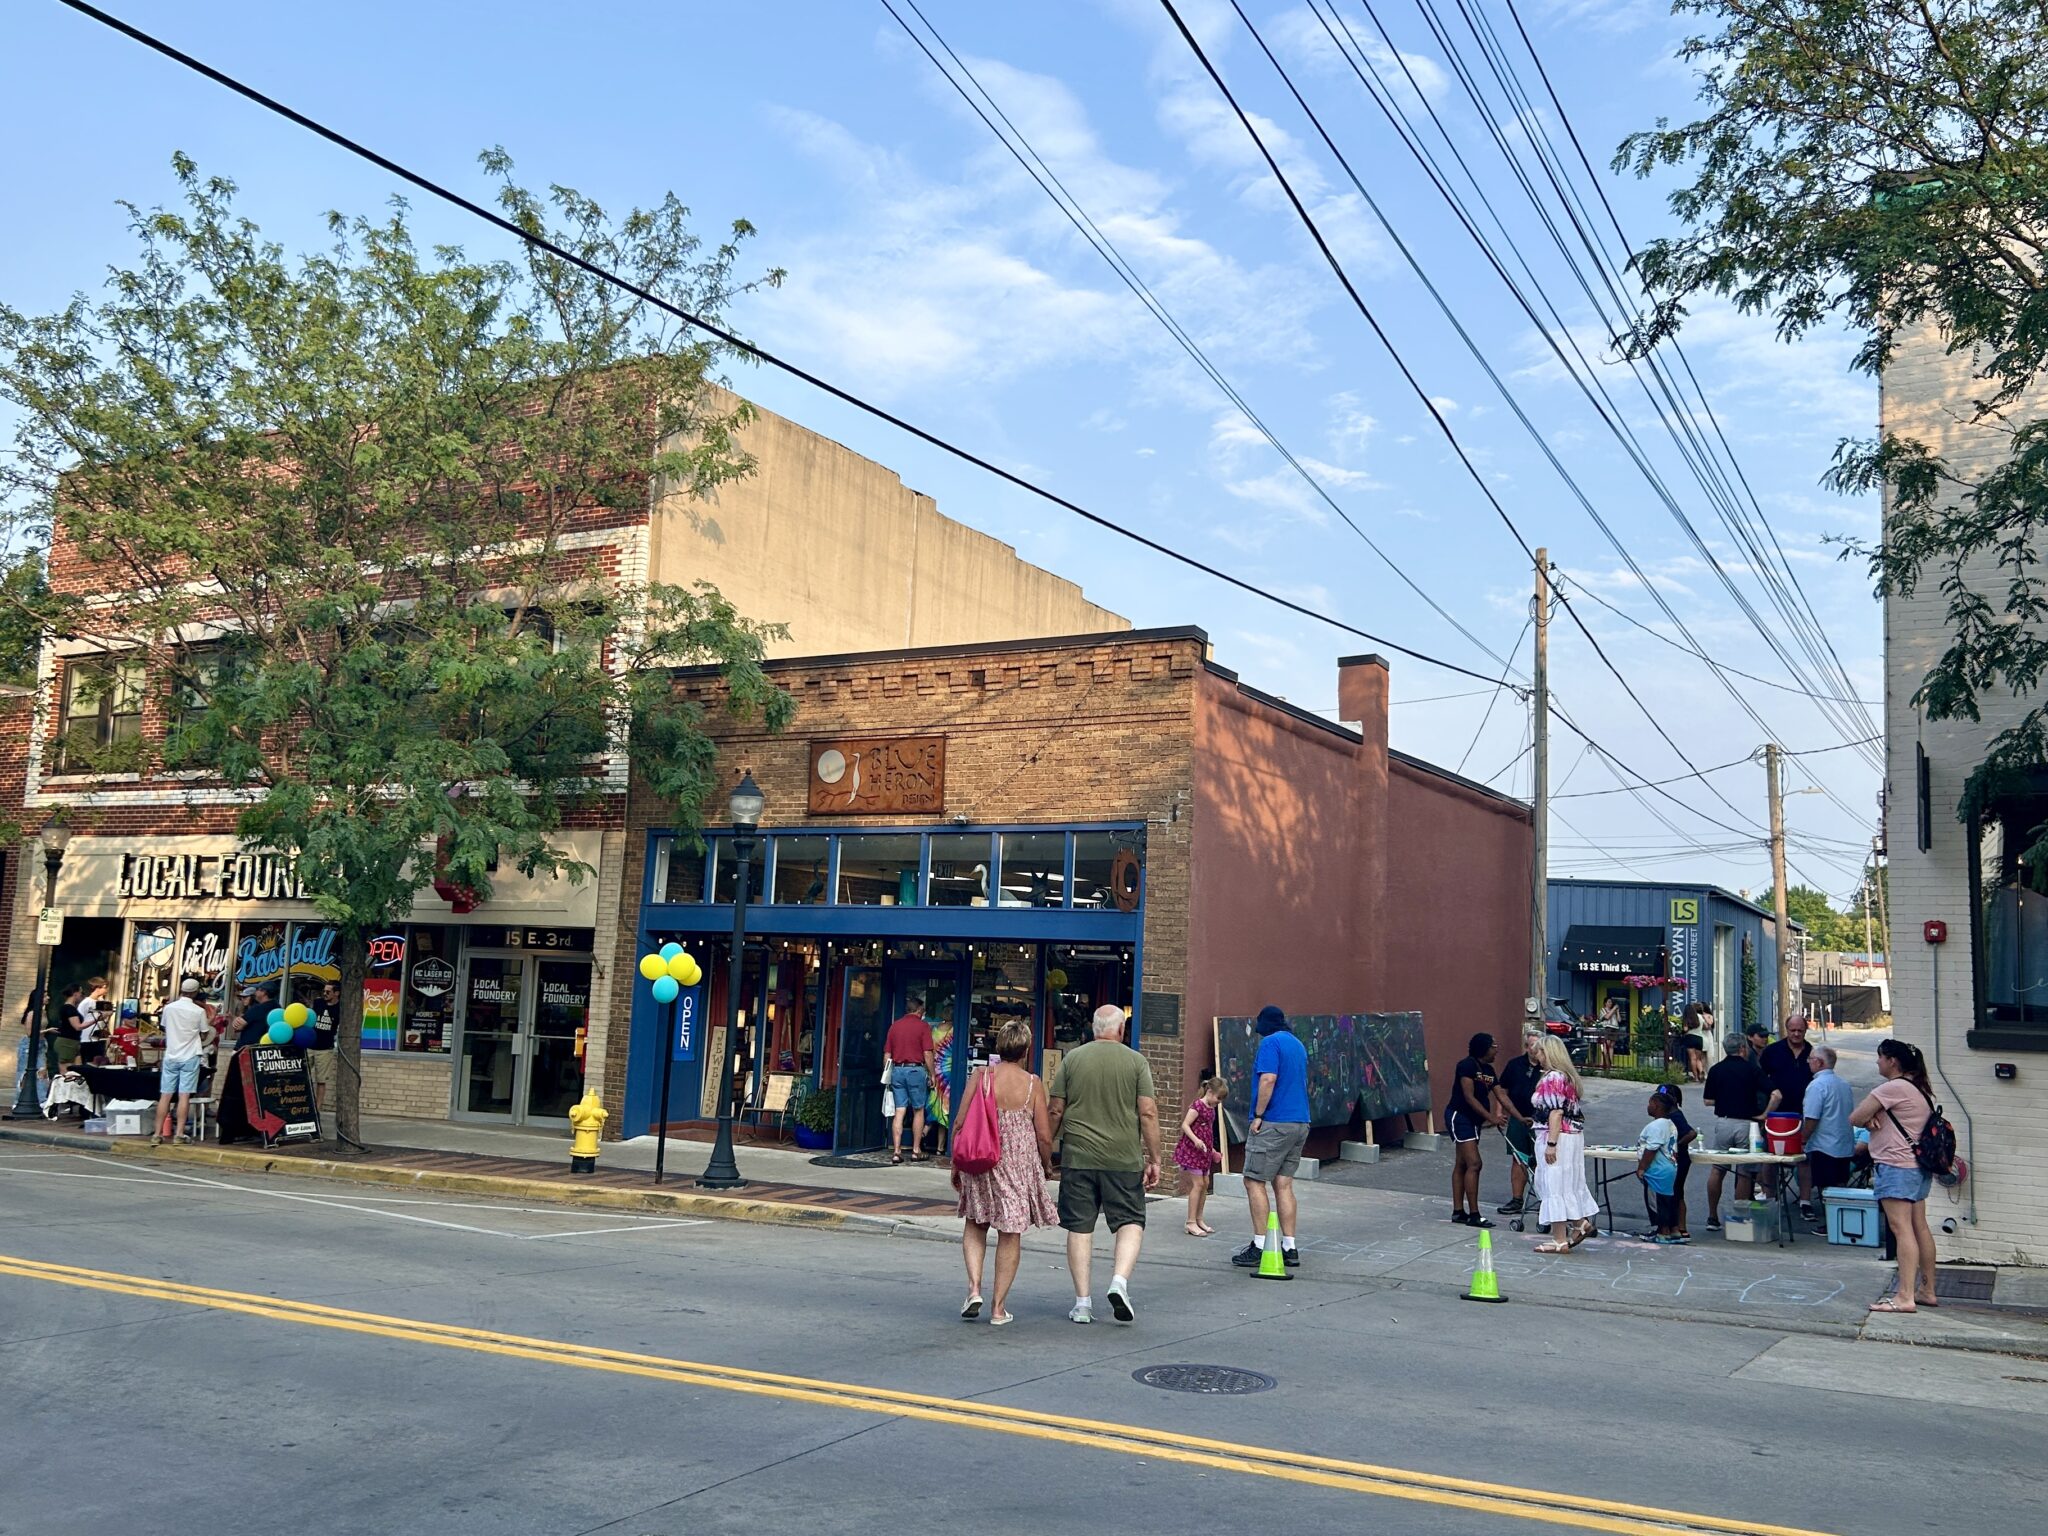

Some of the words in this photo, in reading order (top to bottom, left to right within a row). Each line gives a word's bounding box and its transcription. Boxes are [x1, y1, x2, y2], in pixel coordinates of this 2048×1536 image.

[870, 744, 937, 771] BLUE
[869, 771, 936, 791] HERON
[115, 852, 202, 899] LOCAL
[214, 851, 312, 900] FOUN
[41, 910, 48, 920] 2
[1674, 902, 1695, 921] LS
[505, 931, 520, 945] 15
[527, 932, 541, 945] E.
[1690, 927, 1698, 957] STREET
[202, 932, 230, 992] Play
[236, 926, 337, 984] Baseball
[415, 969, 423, 978] KC
[424, 970, 442, 978] LASER
[1579, 962, 1589, 971] 13
[1589, 962, 1600, 972] SE
[1600, 963, 1620, 972] Third
[1621, 964, 1632, 973] St.
[1690, 957, 1698, 977] MAIN
[474, 979, 500, 990] LOCAL
[543, 982, 570, 993] LOCAL
[1690, 978, 1698, 1003] UMMIT
[473, 989, 517, 1001] FOUNDERY
[542, 993, 587, 1005] FOUNDERY
[256, 1050, 284, 1061] LOCAL
[257, 1059, 303, 1072] FOUNDERY
[704, 1030, 725, 1114] JEWELRY
